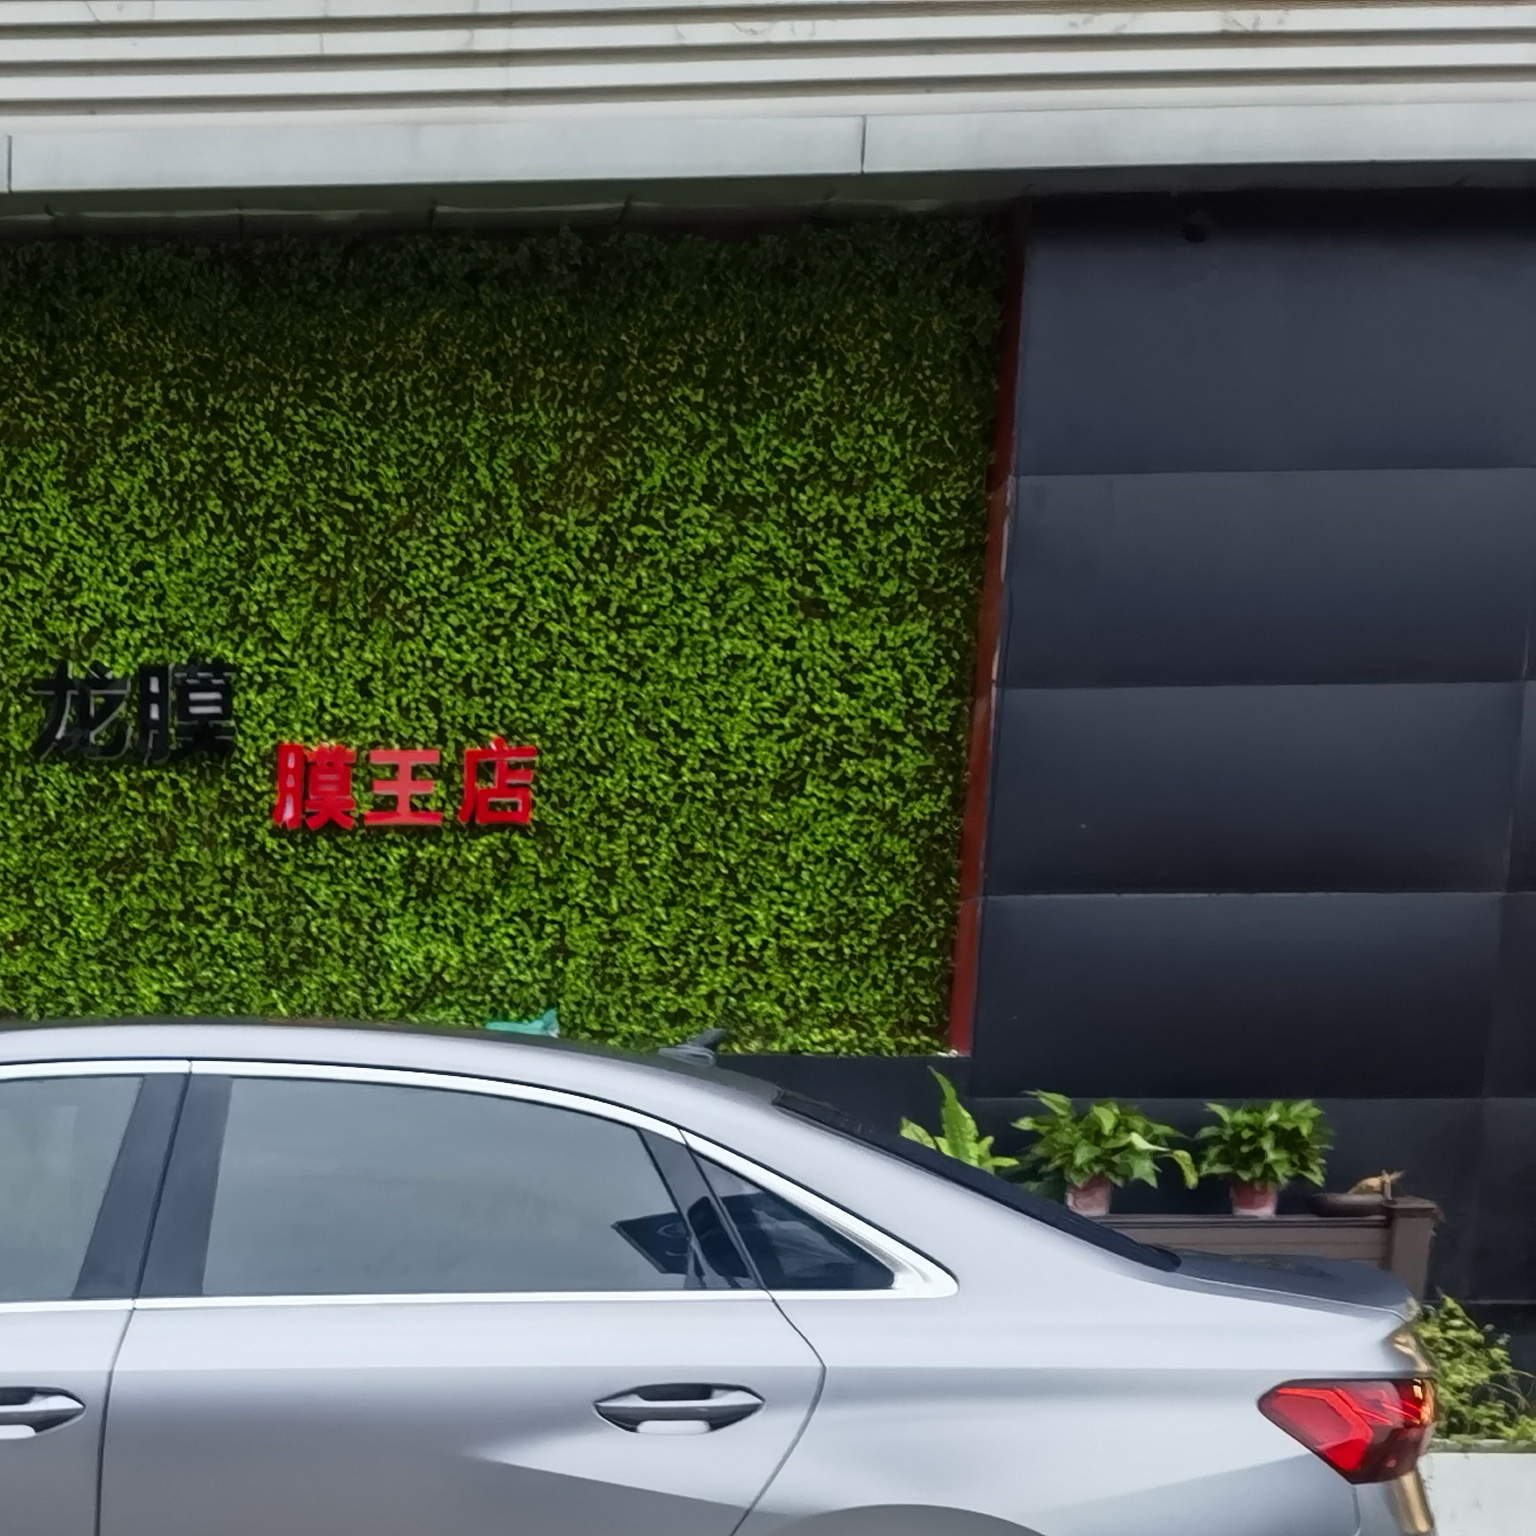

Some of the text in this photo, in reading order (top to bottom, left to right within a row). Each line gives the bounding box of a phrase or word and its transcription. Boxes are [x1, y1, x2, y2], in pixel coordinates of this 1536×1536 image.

[29, 659, 236, 763] 龙膜
[273, 736, 537, 830] 膜王店
